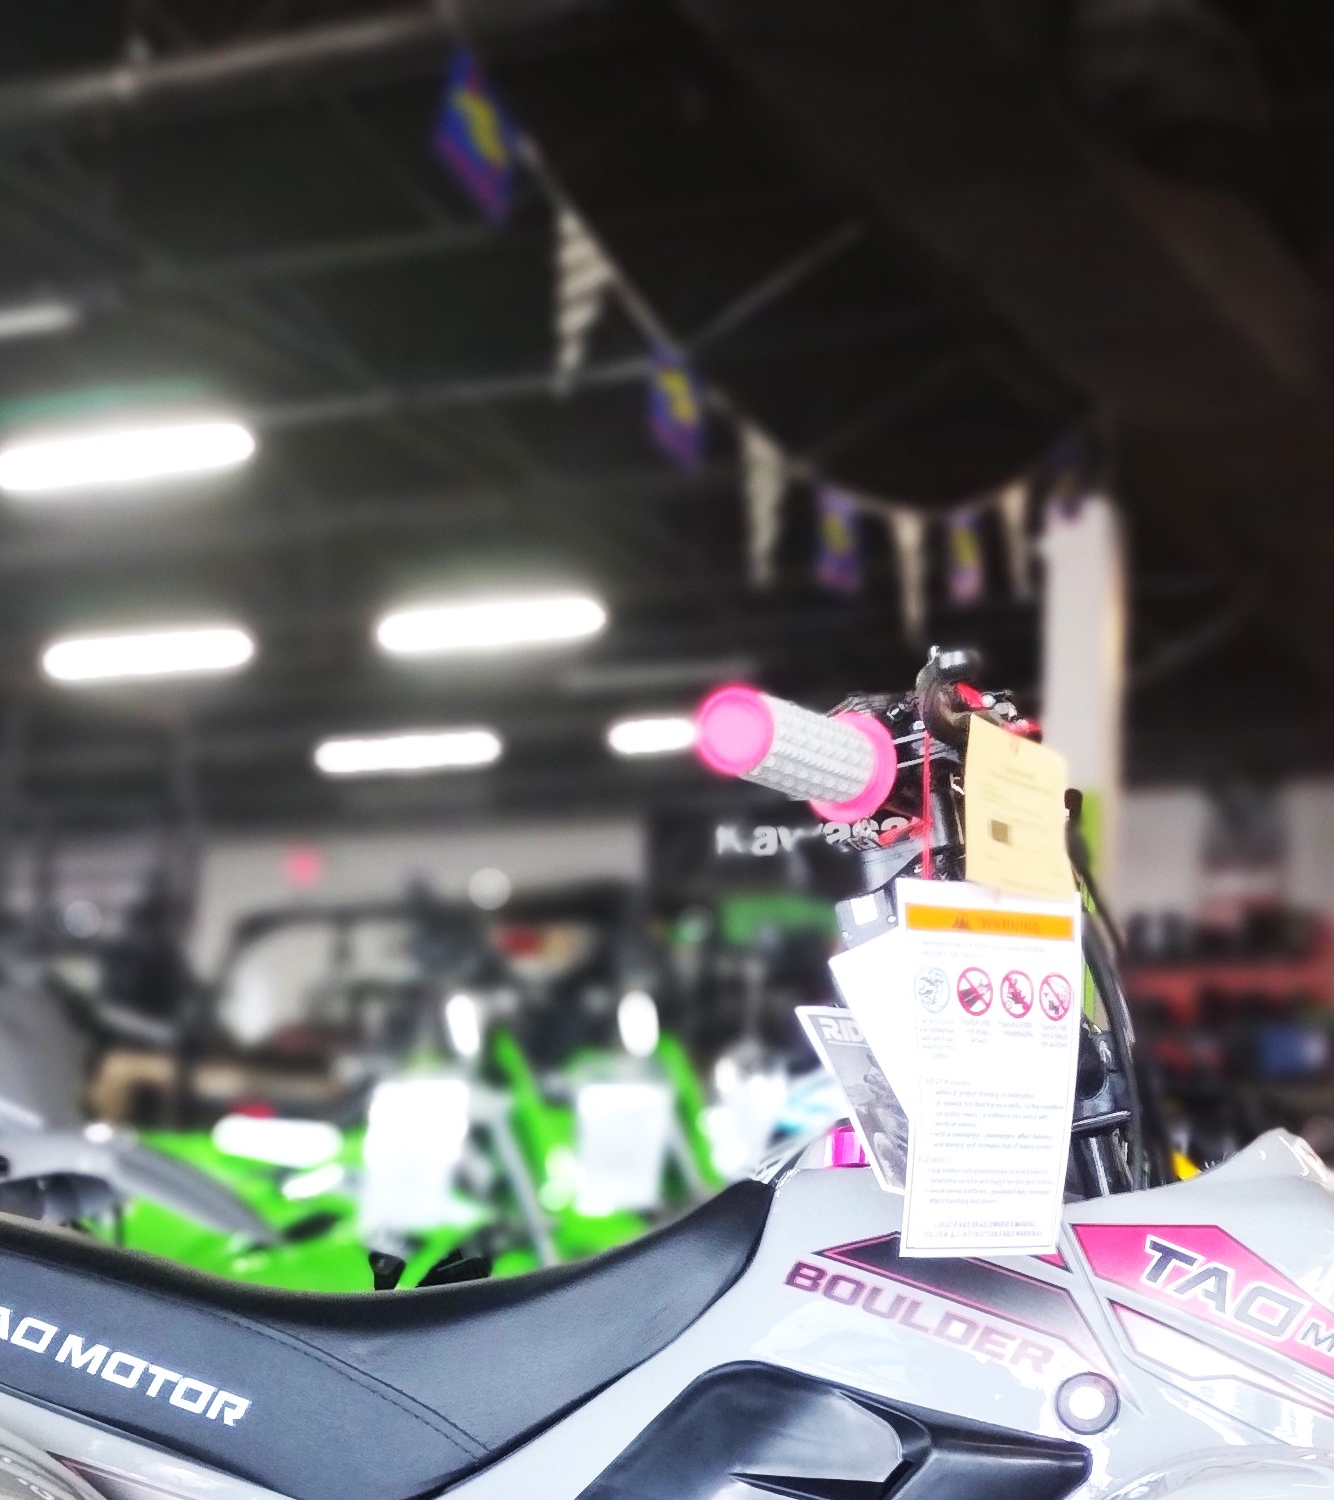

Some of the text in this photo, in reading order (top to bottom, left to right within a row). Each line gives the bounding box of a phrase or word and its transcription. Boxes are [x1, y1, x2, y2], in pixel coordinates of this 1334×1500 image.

[818, 1016, 865, 1042] RID
[783, 1260, 1055, 1375] BOULDER
[1142, 1235, 1309, 1340] TAO
[54, 1332, 252, 1427] MOTOR
